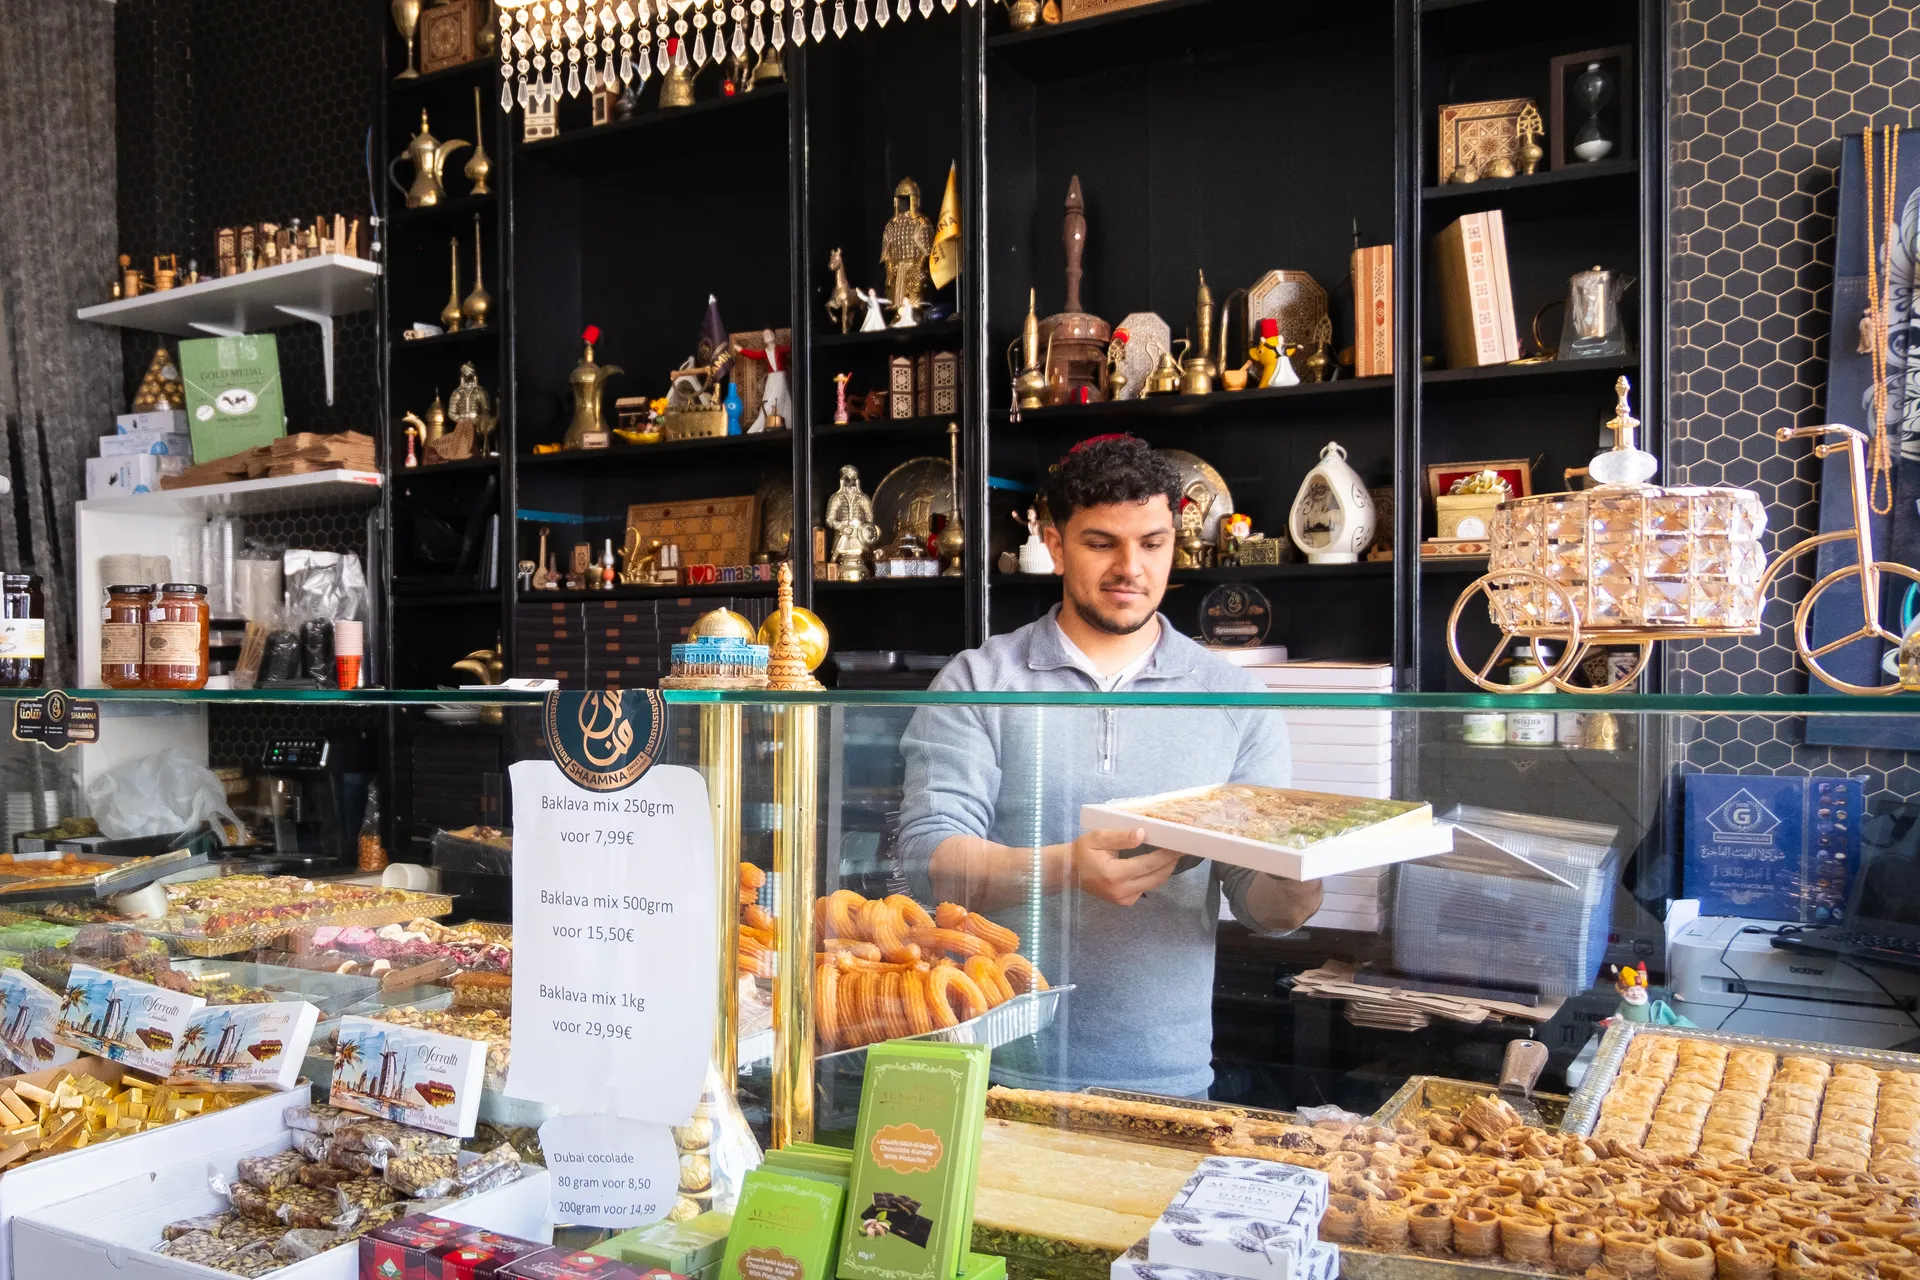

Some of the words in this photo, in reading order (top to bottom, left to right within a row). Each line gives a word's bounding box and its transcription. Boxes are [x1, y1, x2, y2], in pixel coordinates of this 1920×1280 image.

[200, 370, 229, 380] GOLD
[230, 367, 264, 377] MEDAL
[704, 563, 778, 583] Damascus
[569, 763, 628, 785] SHAAMNA
[627, 759, 641, 772] SWEET
[541, 795, 589, 812] Baklava
[593, 798, 620, 813] mix
[623, 799, 675, 817] 250grm
[1733, 808, 1751, 825] G
[560, 831, 590, 843] voor
[594, 830, 634, 846] 7,99€
[540, 890, 589, 907] Baklava
[593, 895, 619, 909] mix
[623, 895, 673, 915] 500grm
[552, 925, 582, 938] voor
[587, 926, 634, 942] 15,50€
[1789, 965, 1824, 976] brother
[539, 984, 587, 1003] Baklava
[592, 991, 617, 1006] mix
[621, 993, 645, 1012] 1kg
[552, 1020, 581, 1034] voor
[585, 1021, 633, 1040] 29,99€
[553, 1152, 585, 1163] Dubai
[587, 1153, 634, 1163] cocolade
[880, 1145, 910, 1154] Chocolate
[883, 1153, 898, 1161] With
[899, 1155, 927, 1164] Pistachio
[558, 1176, 571, 1187] 80
[573, 1178, 599, 1190] gram
[601, 1180, 626, 1189] voor
[628, 1178, 651, 1191] 8,50
[558, 1201, 600, 1216] 200gram
[603, 1206, 628, 1215] voor
[629, 1204, 656, 1216] 14,99
[746, 1261, 774, 1273] Chocolate
